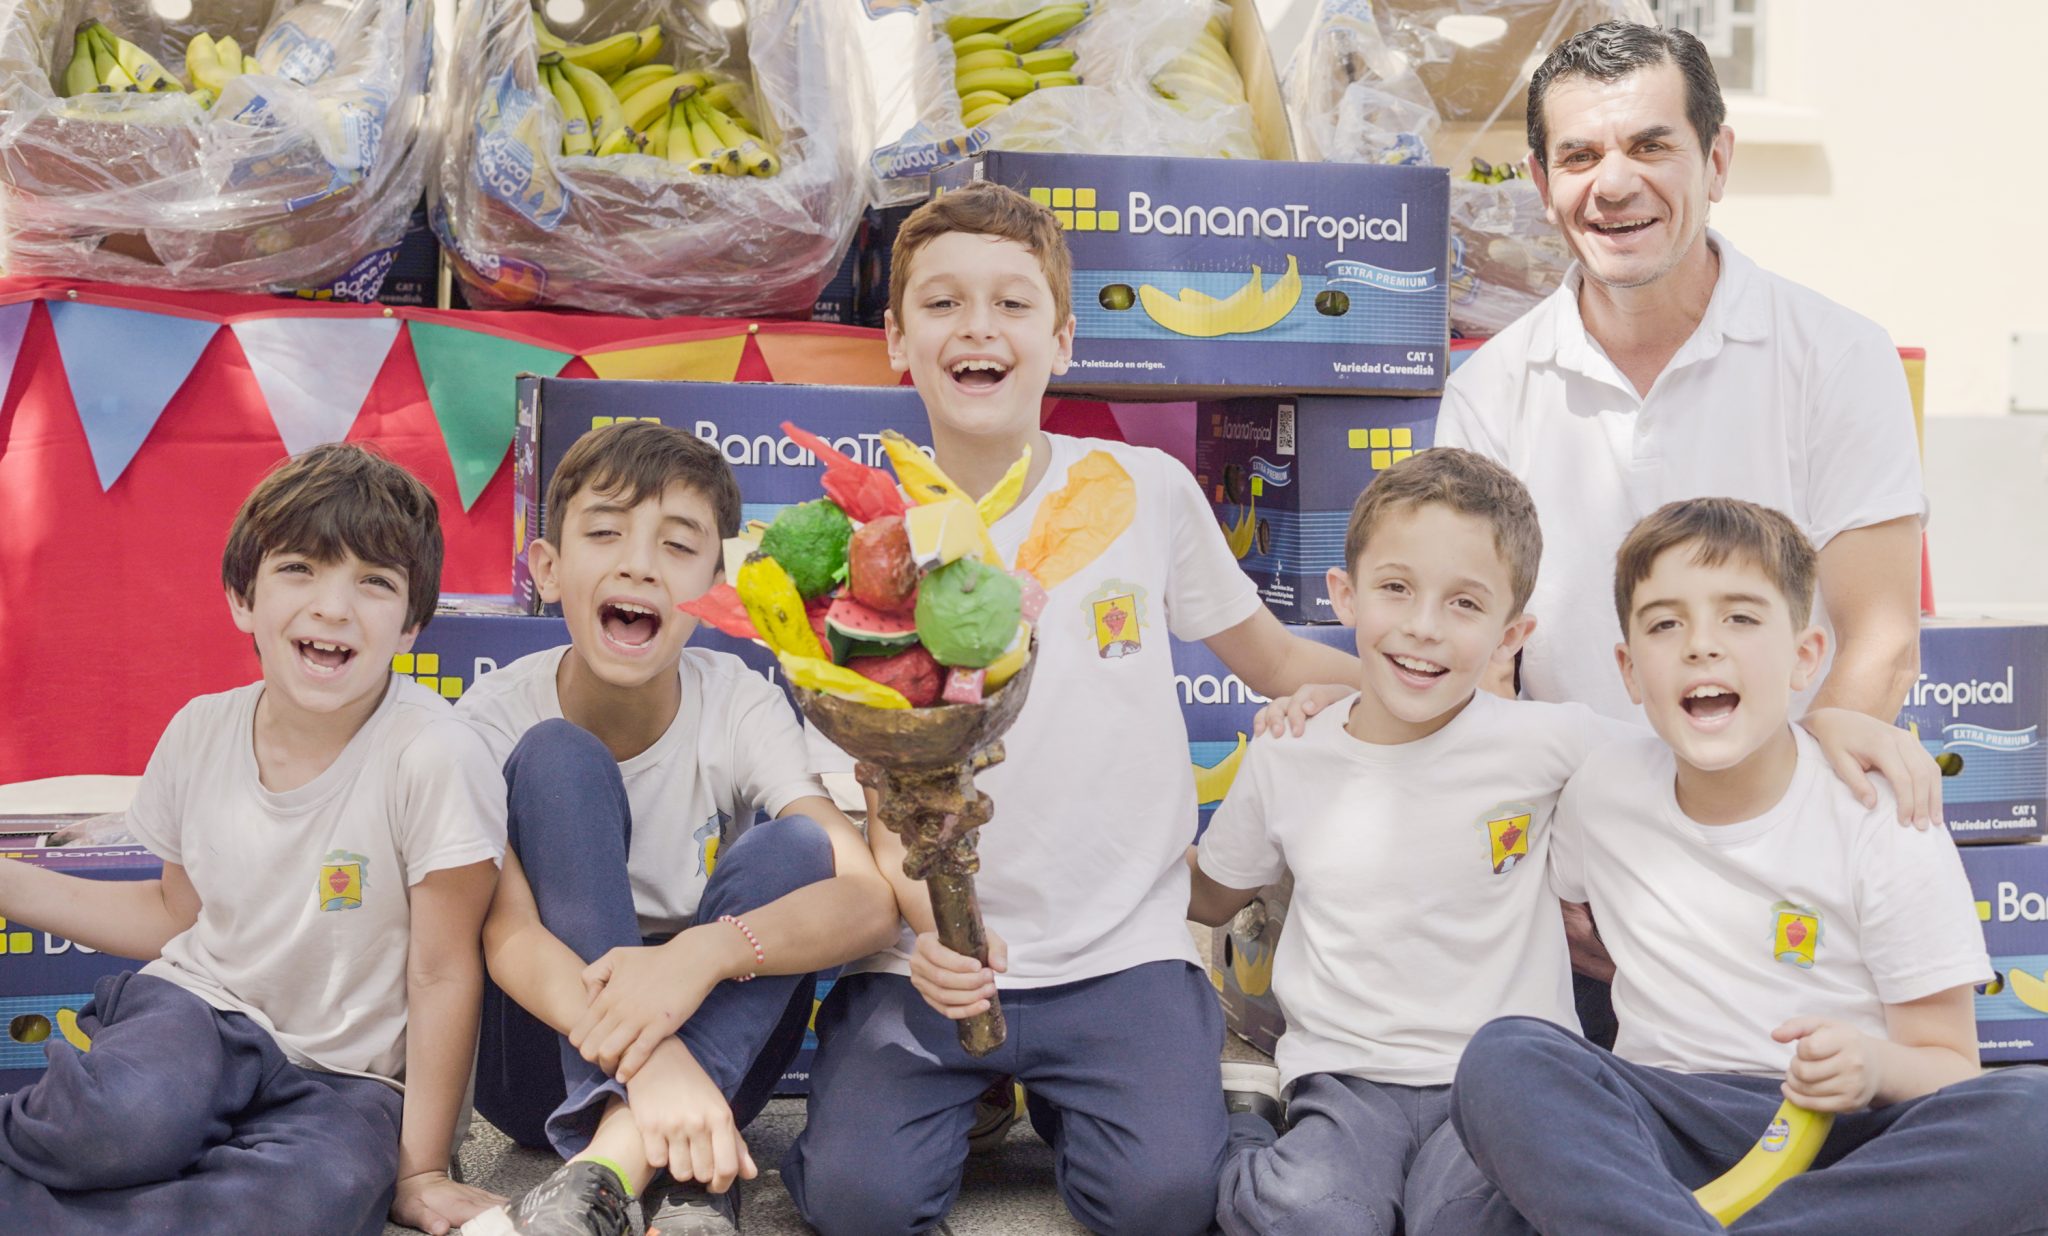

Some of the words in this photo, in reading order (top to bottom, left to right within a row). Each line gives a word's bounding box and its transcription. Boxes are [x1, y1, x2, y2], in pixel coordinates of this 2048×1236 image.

[1129, 191, 1407, 252] BananaTropical
[1338, 265, 1373, 280] EXTRA
[1376, 273, 1428, 287] PREMIUM
[1406, 351, 1426, 362] CAT
[1428, 352, 1434, 362] 1
[1081, 360, 1124, 369] Paletizado
[1137, 361, 1165, 370] origen.
[1333, 362, 1381, 373] Variedad
[1382, 364, 1434, 375] Cavendish
[1316, 598, 1333, 606] Pro
[1953, 730, 1984, 742] EXTRA
[1985, 734, 2031, 746] PREMIUM
[2012, 805, 2029, 815] CAT
[2031, 805, 2036, 814] 1
[1949, 820, 1991, 831] Variedad
[1992, 817, 2037, 829] Cavendish
[1998, 881, 2048, 922] Ba
[787, 1071, 810, 1081] orige
